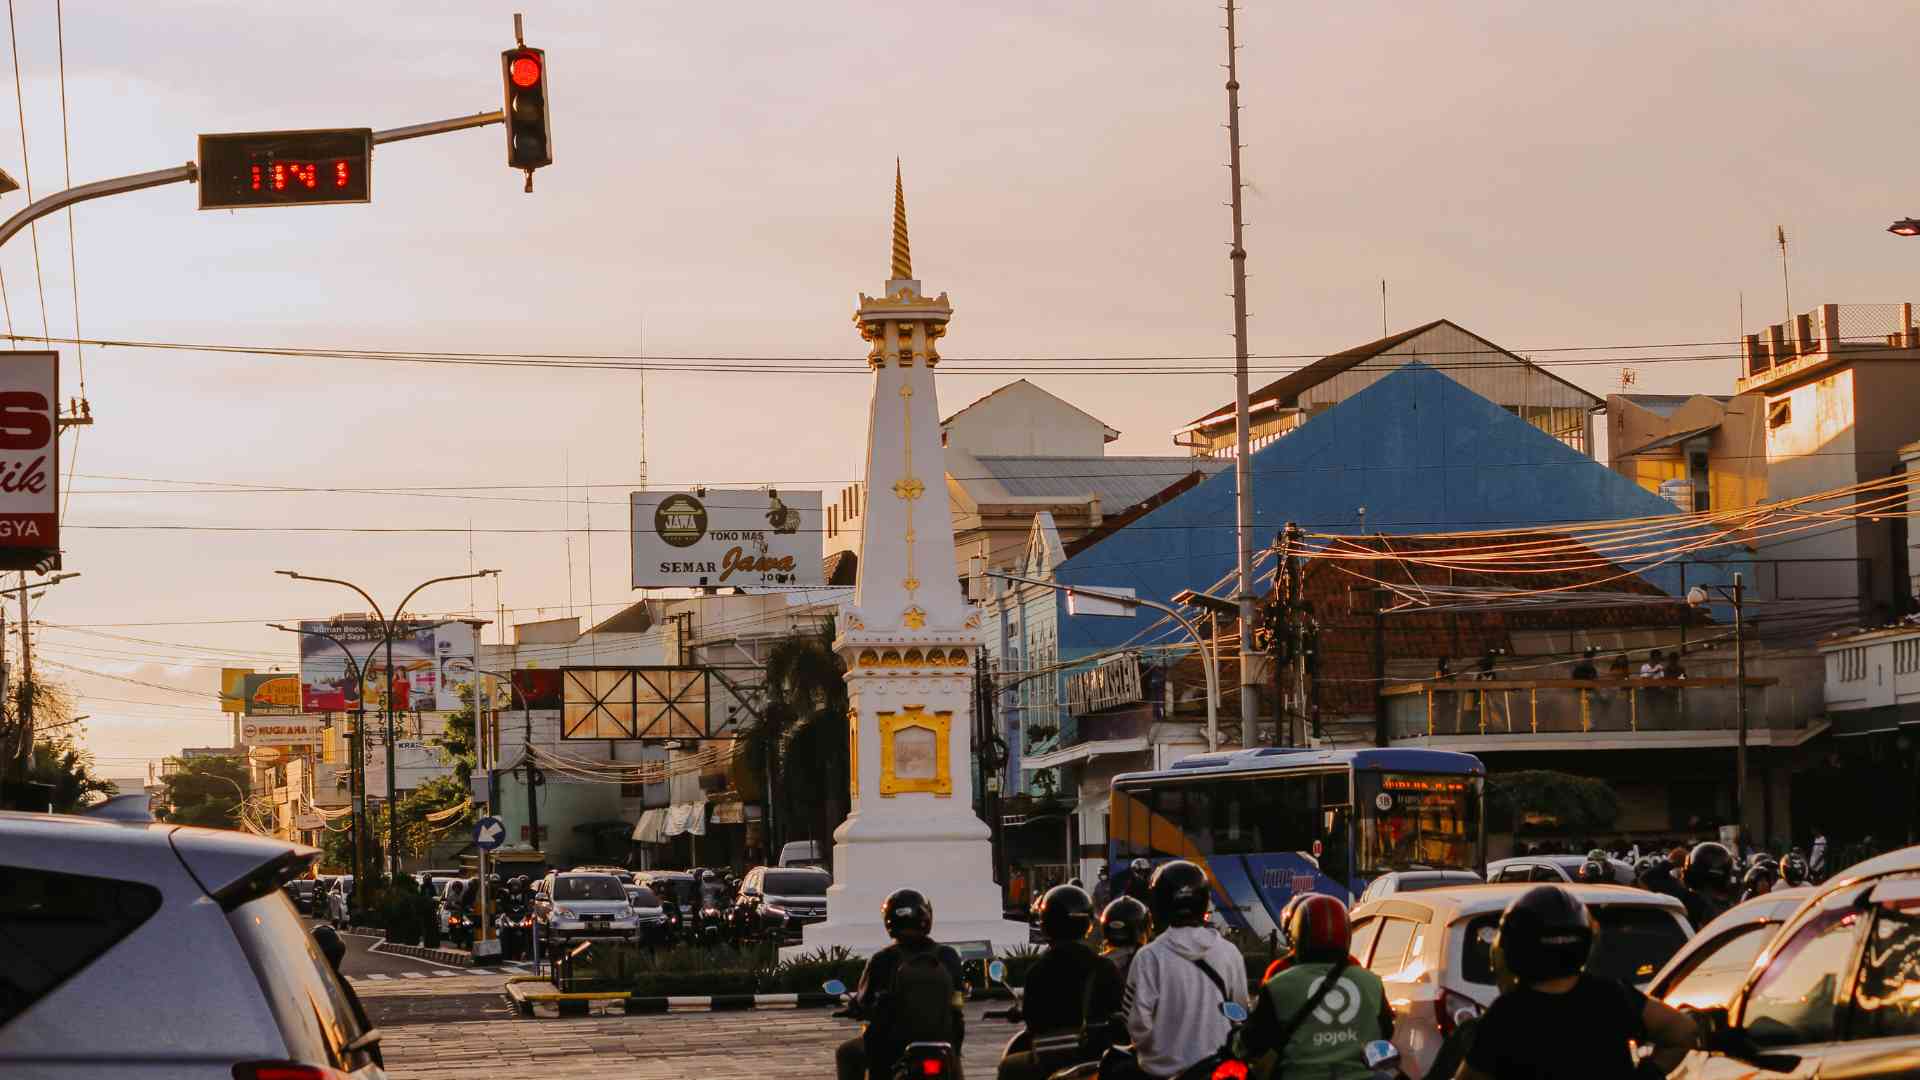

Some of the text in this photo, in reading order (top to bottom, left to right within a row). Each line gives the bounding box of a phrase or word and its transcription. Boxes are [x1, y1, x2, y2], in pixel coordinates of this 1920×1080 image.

[0, 456, 47, 494] ik
[665, 515, 697, 529] JAWA
[710, 531, 764, 541] TOKO MAS
[660, 562, 717, 573] SEMAR
[1313, 1028, 1358, 1046] gojek
